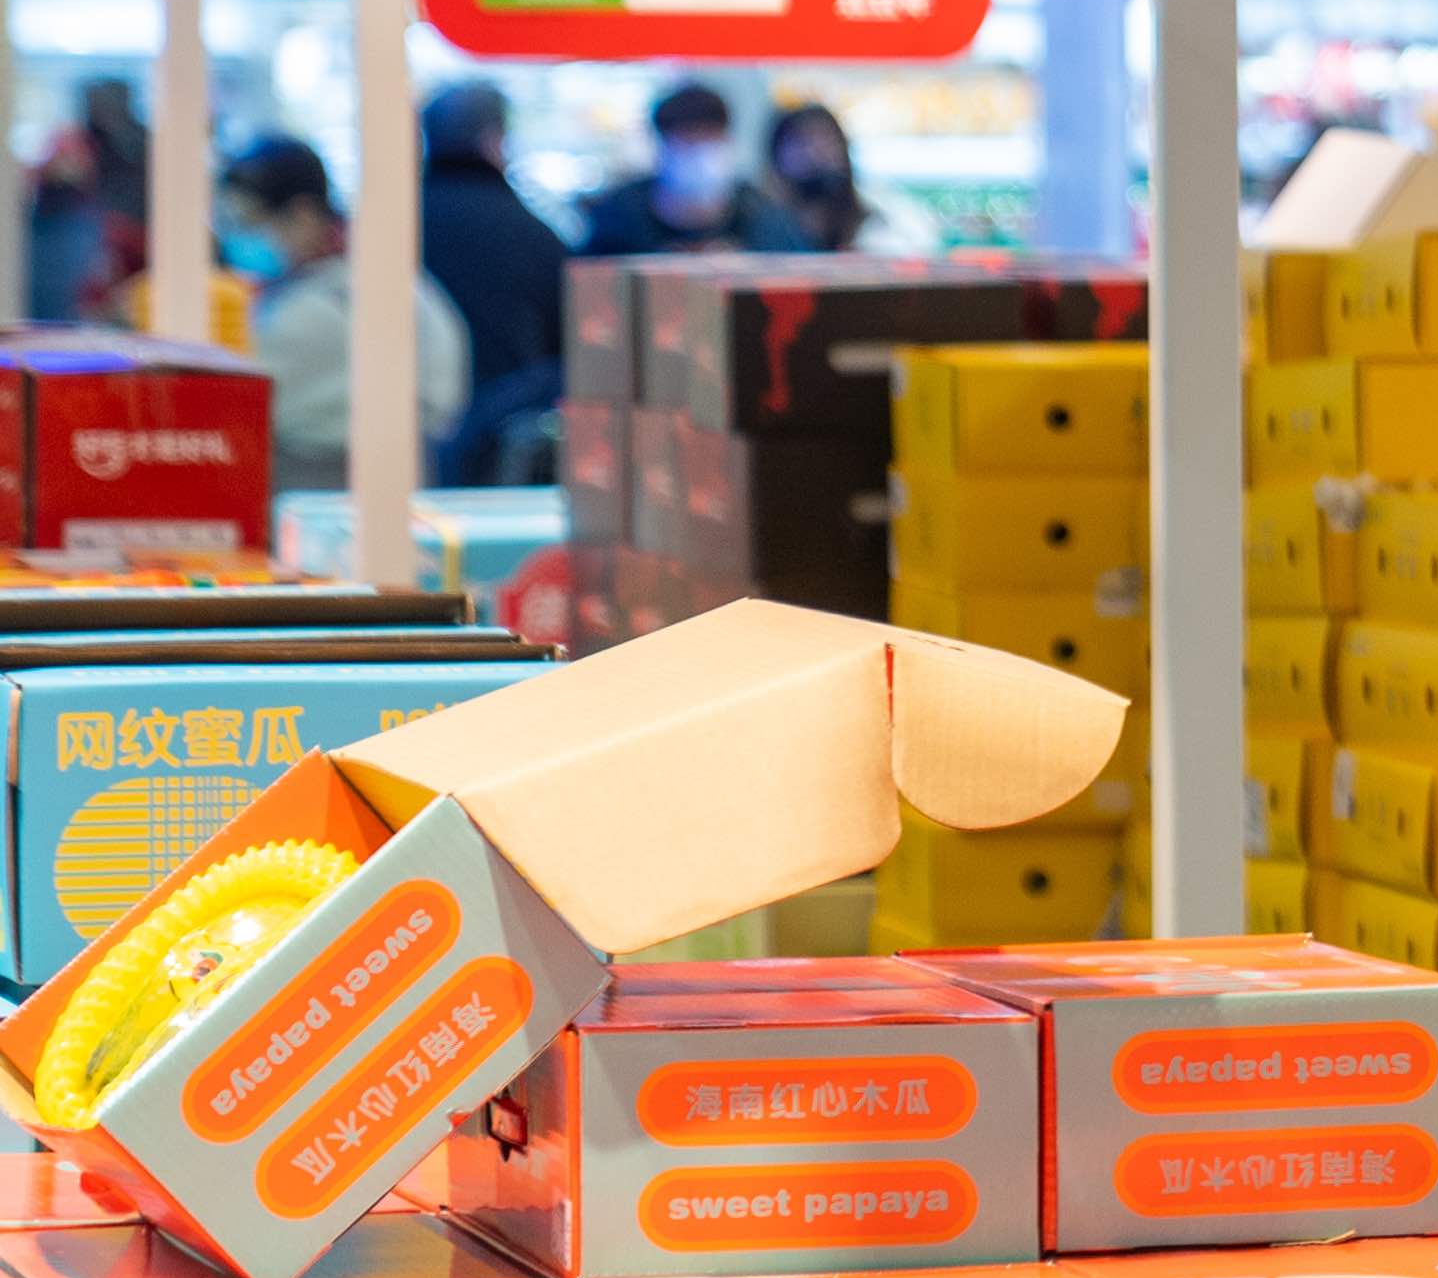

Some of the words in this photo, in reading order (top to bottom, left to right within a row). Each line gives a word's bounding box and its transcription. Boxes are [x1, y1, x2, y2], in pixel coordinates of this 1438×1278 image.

[56, 706, 306, 771] 网纹蜜瓜
[330, 908, 434, 1008] sweet
[208, 1001, 334, 1118] papaya
[1140, 1049, 1285, 1090] papaya
[1295, 1052, 1412, 1086] sweet
[290, 990, 498, 1187] 海南红心木瓜
[685, 1077, 931, 1122] 海南红心木瓜
[1158, 1149, 1397, 1196] 海南红心木瓜
[668, 1188, 793, 1223] sweet
[803, 1186, 950, 1230] papaya
